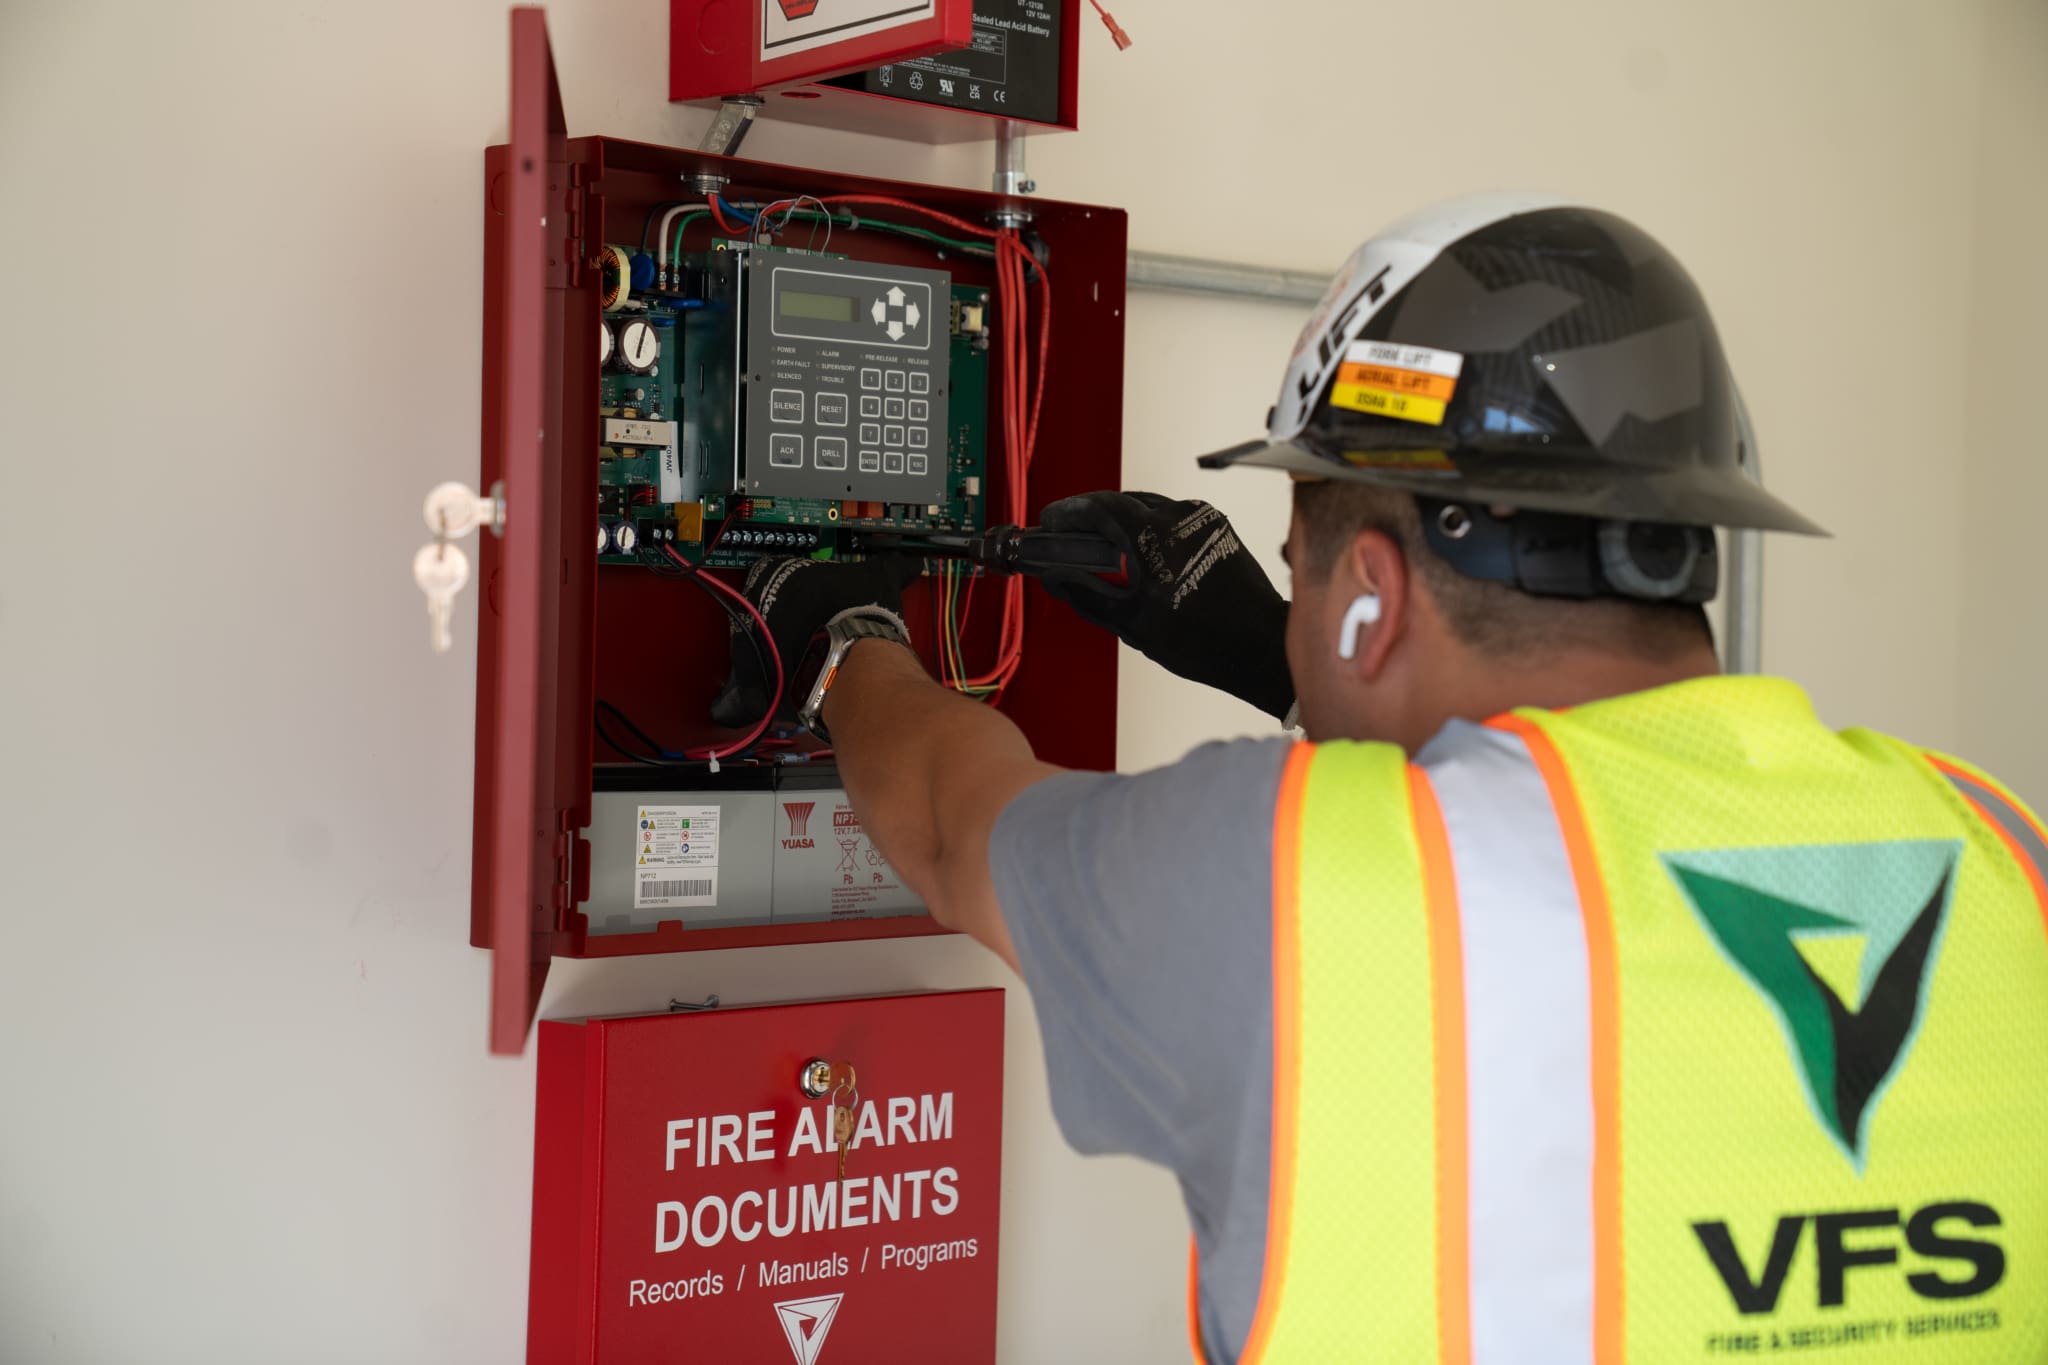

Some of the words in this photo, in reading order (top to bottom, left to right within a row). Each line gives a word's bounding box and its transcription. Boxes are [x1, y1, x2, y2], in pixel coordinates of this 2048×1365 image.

[972, 13, 994, 25] Sealed
[995, 17, 1011, 29] Lead
[1011, 21, 1027, 31] Acid
[1027, 24, 1050, 38] Battery
[777, 359, 793, 367] EARTH
[794, 360, 811, 368] FAULT
[821, 363, 856, 372] SUPERVISORY
[821, 375, 844, 383] TROUBLE
[773, 401, 801, 410] SILENCE
[821, 405, 842, 413] RESET
[822, 449, 840, 457] DRILL
[782, 838, 815, 849] YUASA
[843, 873, 853, 884] Pb
[873, 872, 883, 883] Pb
[665, 1110, 776, 1171] FIRE
[787, 1092, 953, 1157] ALARM
[655, 1167, 959, 1253] DOCUMENTS
[1690, 1200, 2006, 1315] VFS
[629, 1269, 724, 1307] Records
[737, 1264, 745, 1291] /
[759, 1252, 849, 1288] Manuals
[861, 1247, 869, 1273] /
[881, 1238, 978, 1271] Programs
